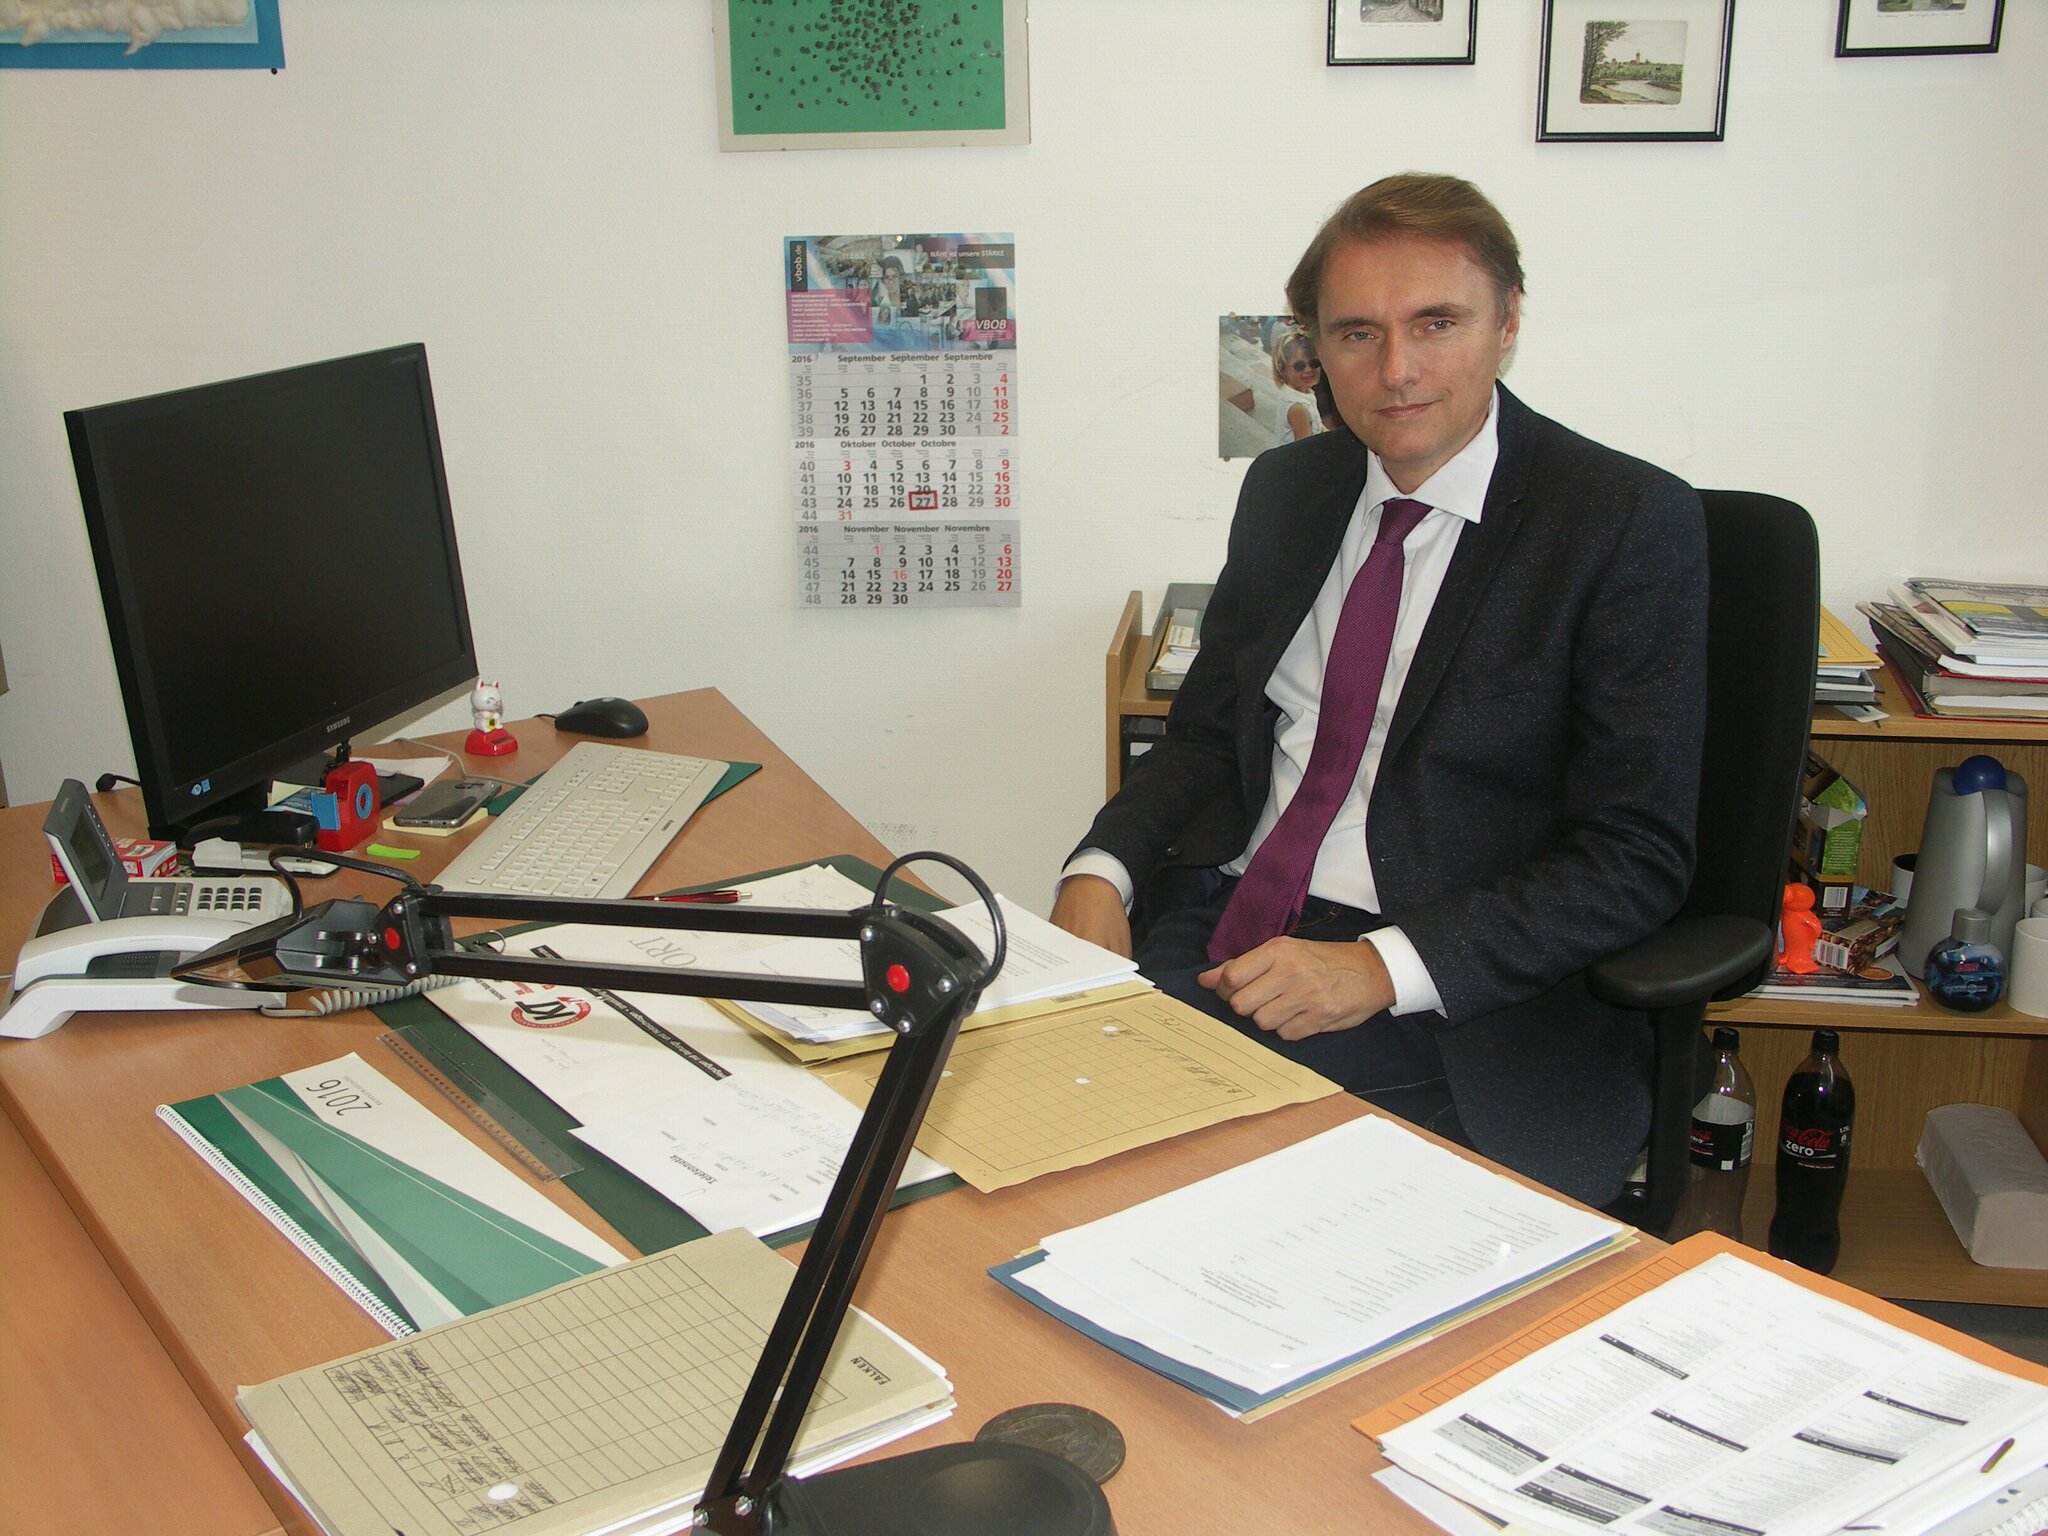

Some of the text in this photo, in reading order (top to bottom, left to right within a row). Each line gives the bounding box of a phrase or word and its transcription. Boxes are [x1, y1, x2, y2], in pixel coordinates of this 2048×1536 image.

[794, 244, 802, 282] vbob.de
[975, 319, 1007, 329] VBOB
[838, 354, 886, 363] September
[891, 354, 939, 362] September
[944, 353, 992, 362] Septembre
[796, 373, 1008, 386] 35 1 2 3 4
[797, 386, 1007, 399] 36 5 6 7 8 9 10 11
[798, 399, 1008, 412] 37 12 13 14 15 16 17 18
[798, 411, 1008, 424] 38 19 20 21 22 23 24 25
[798, 424, 1008, 437] 39 26 27 28 29 30 1 2
[921, 440, 956, 448] Octobre
[799, 459, 1009, 471] 40 3 4 5 6 7 8 9
[800, 471, 1010, 483] 41 10 11 12 13 14 15 16
[801, 484, 1010, 495] 42 17 18 19 20 21 22 23
[801, 496, 1010, 508] 43 24 25 26 27 28 29 30
[802, 510, 852, 520] 44 31
[844, 525, 889, 533] November
[894, 525, 939, 533] November
[803, 544, 1012, 556] 44 1 2 3 4 5 6
[803, 556, 1012, 568] 45 7 8 9 10 11 12 13
[804, 568, 1012, 580] 46 14 15 16 17 18 19 20
[805, 580, 1012, 592] 47 21 22 23 24 25 26 27
[805, 594, 908, 604] 48 28 29 30
[306, 1079, 373, 1117] 2016
[1785, 1139, 1815, 1157] zero
[670, 1154, 719, 1185] Telefonnotiz
[849, 1357, 889, 1386] FALKEN
